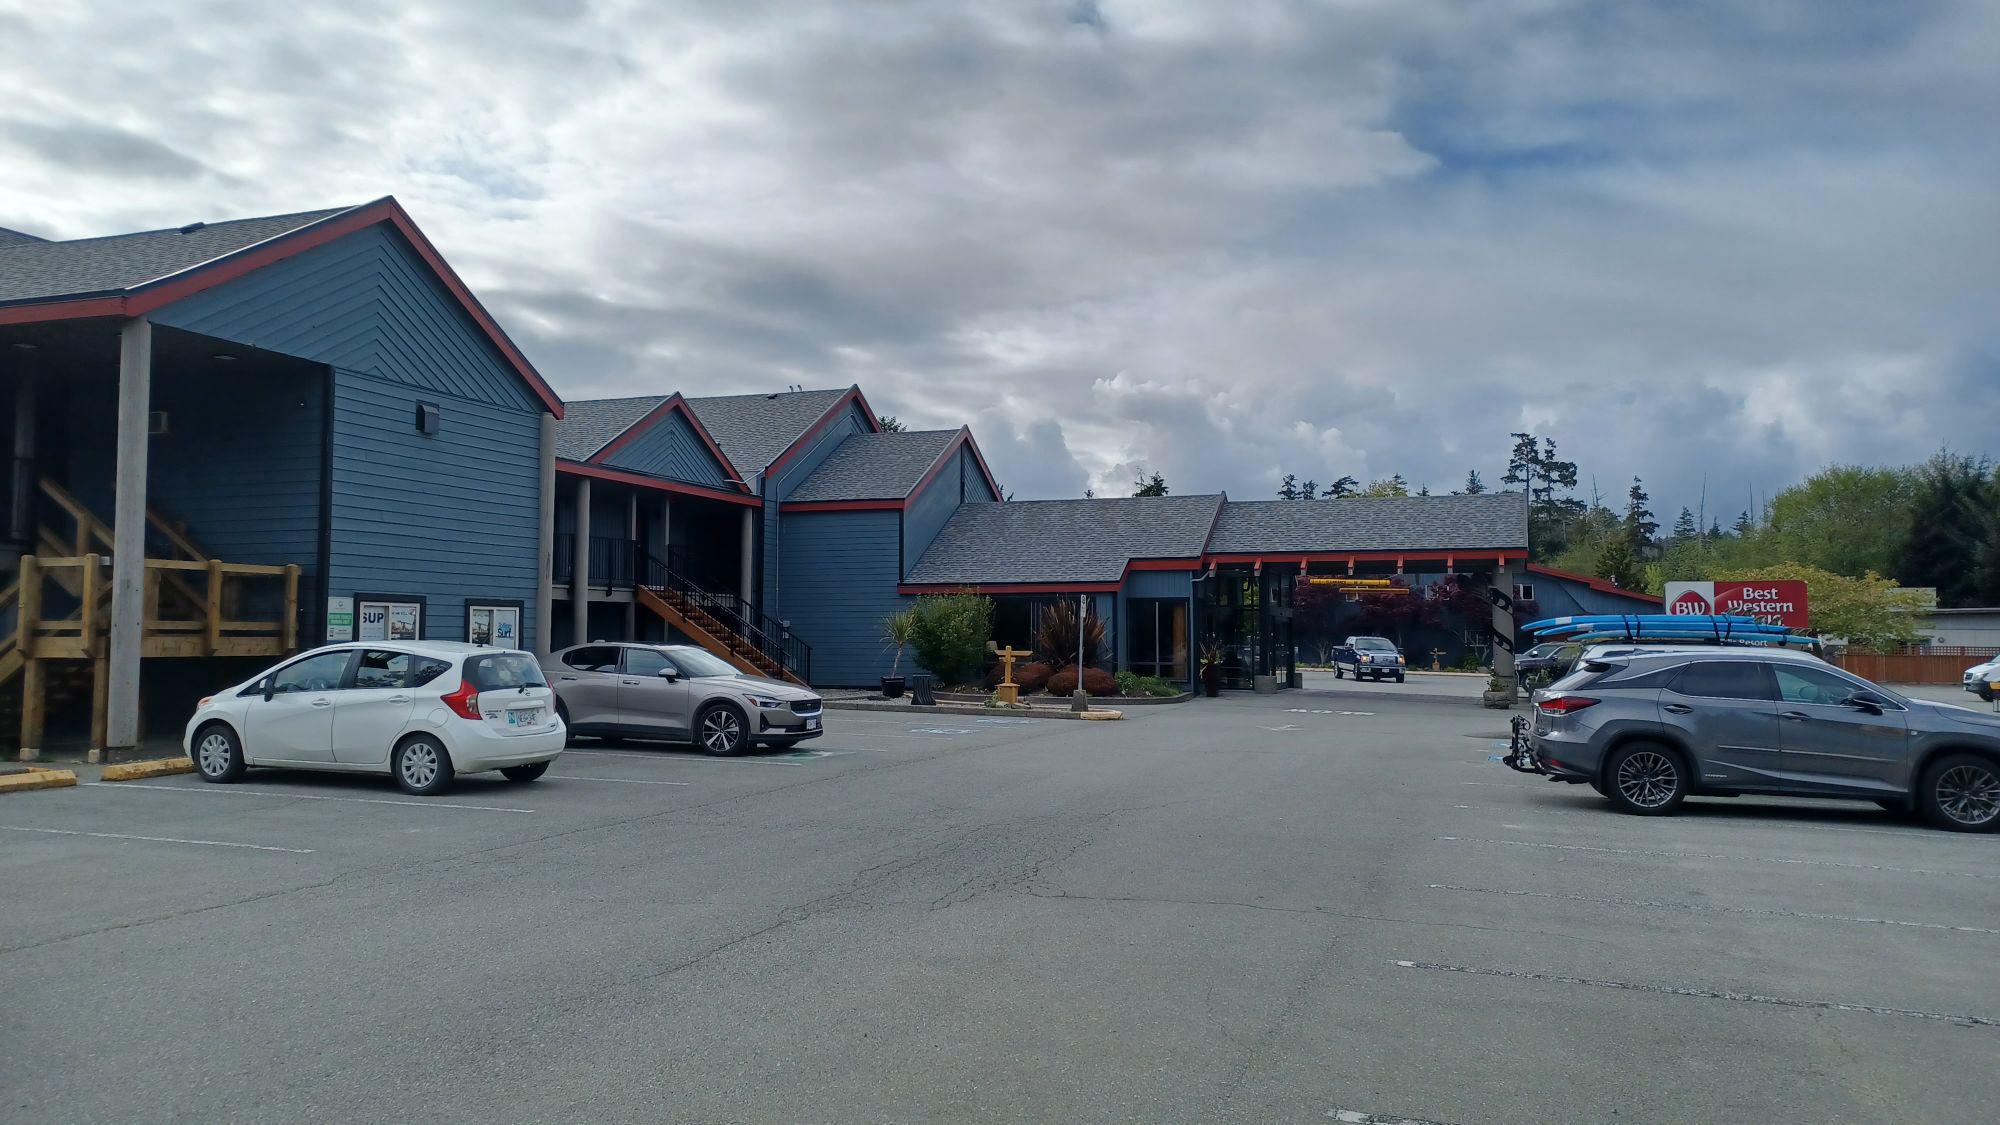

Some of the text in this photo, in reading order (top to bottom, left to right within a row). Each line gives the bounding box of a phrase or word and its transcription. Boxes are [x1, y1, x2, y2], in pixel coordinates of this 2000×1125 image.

[1743, 587, 1779, 600] Best
[1675, 602, 1705, 616] BW
[1727, 600, 1794, 613] Western
